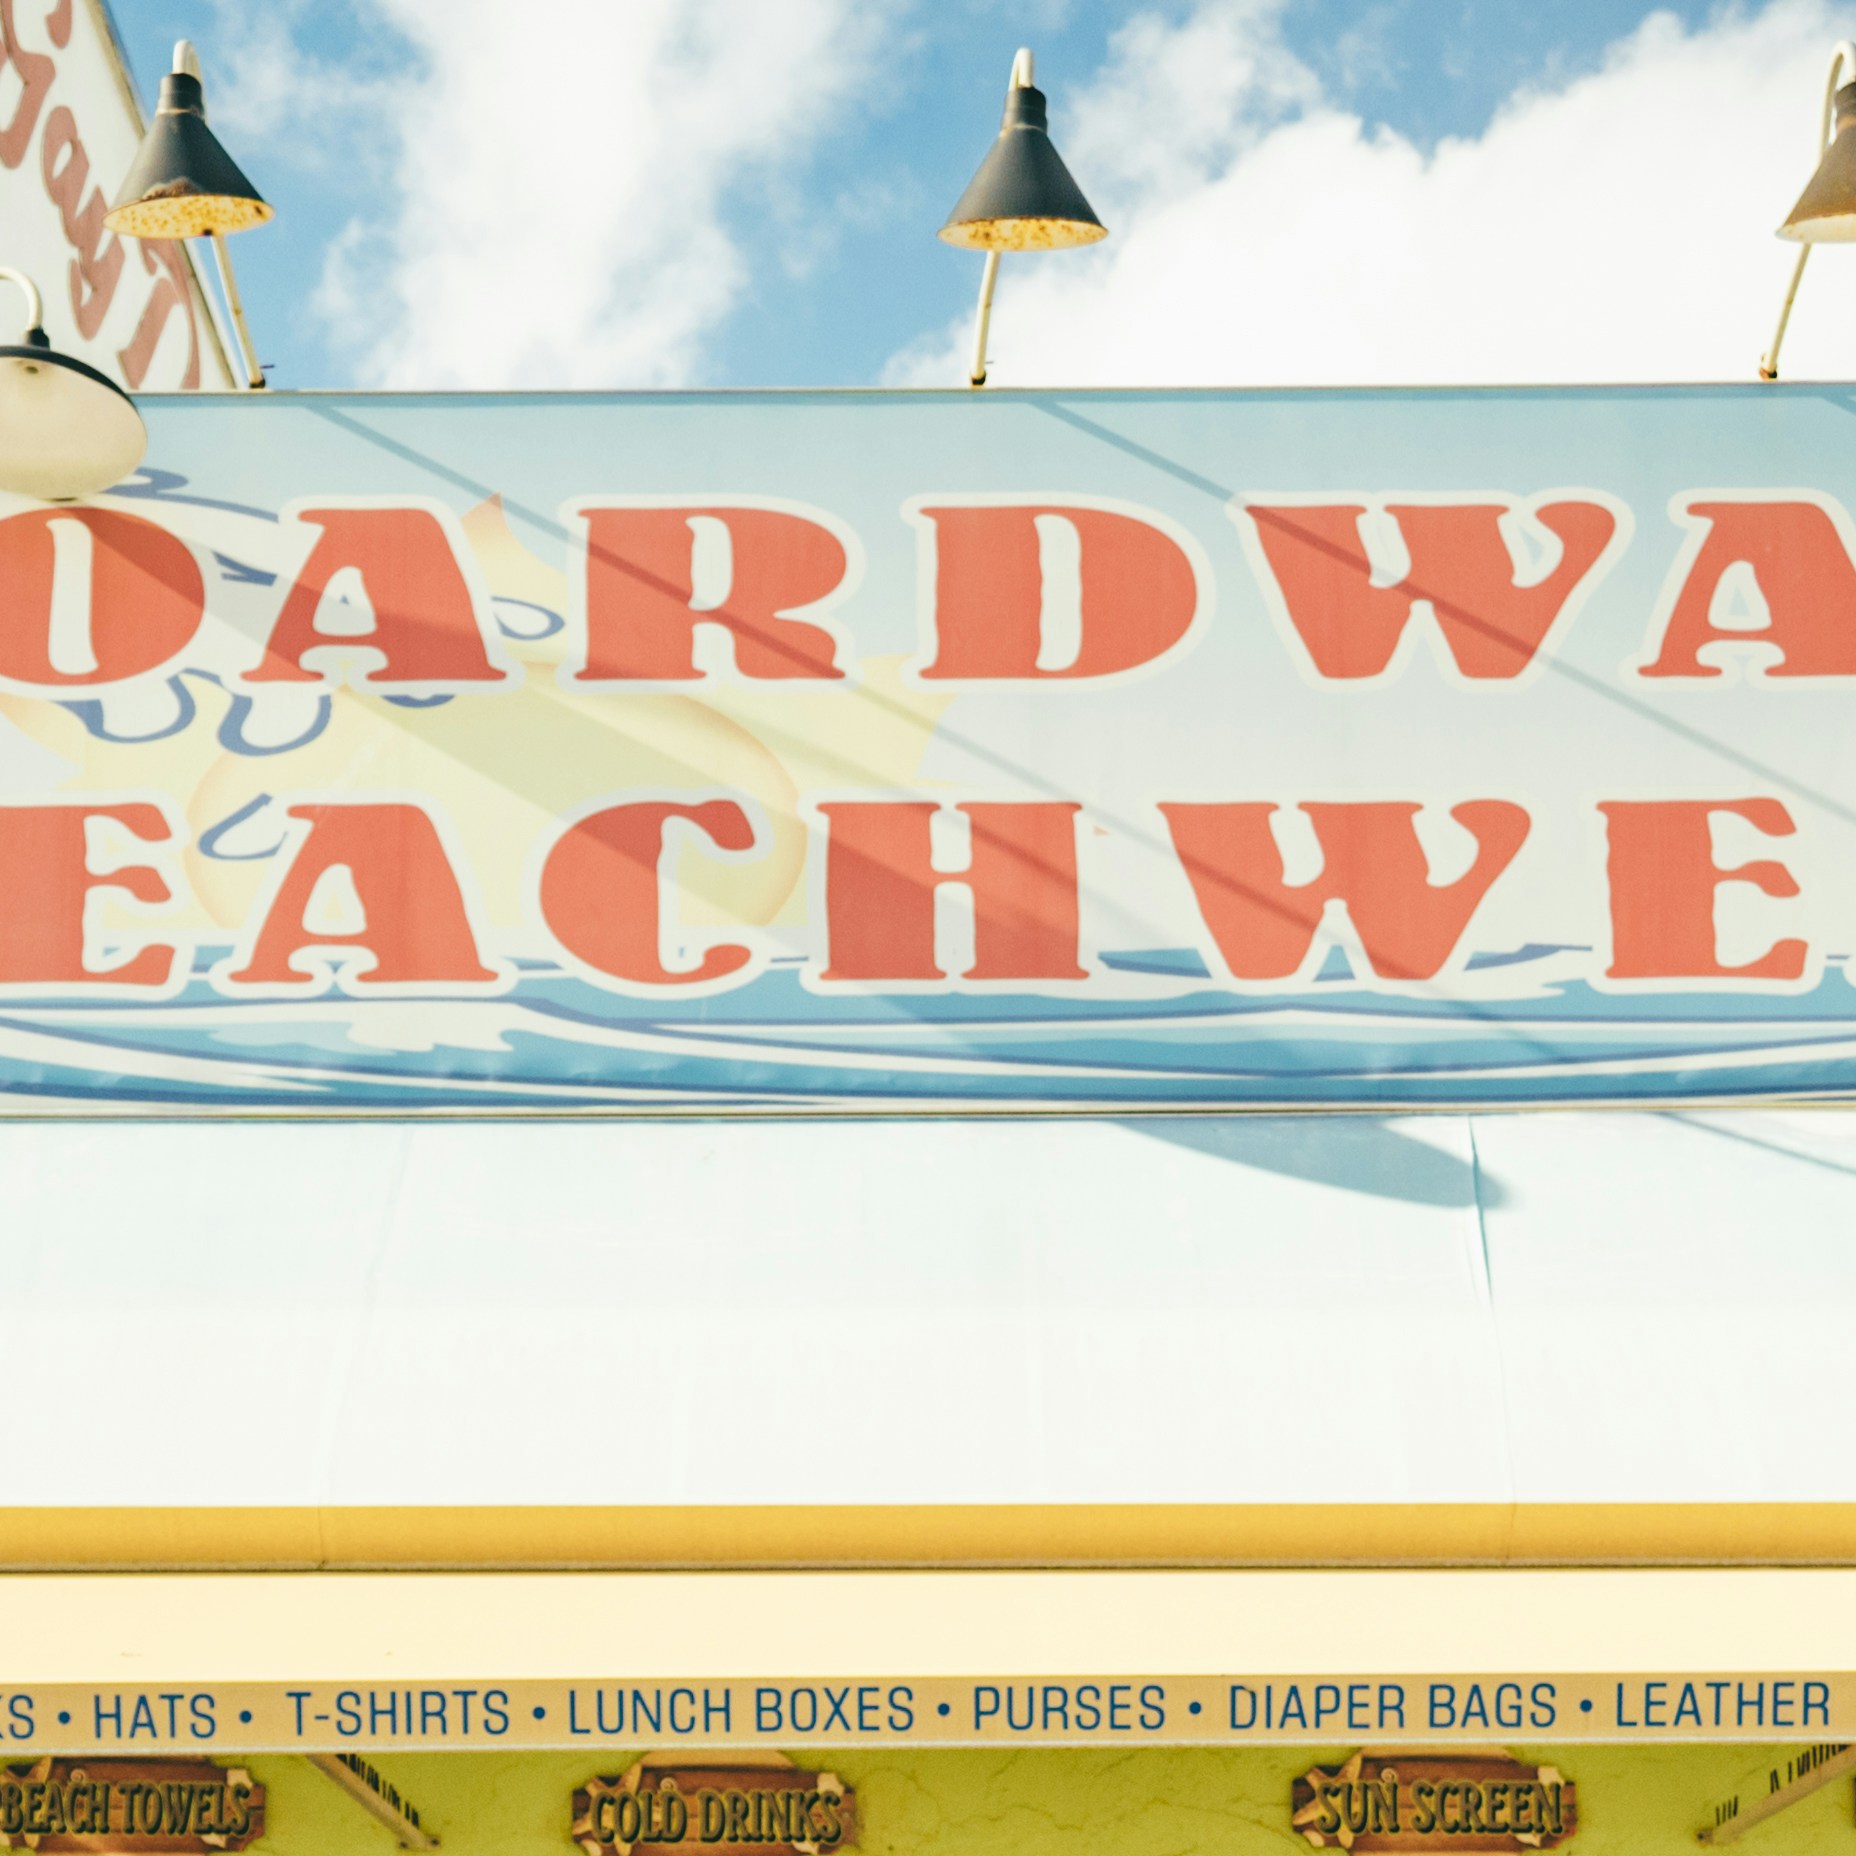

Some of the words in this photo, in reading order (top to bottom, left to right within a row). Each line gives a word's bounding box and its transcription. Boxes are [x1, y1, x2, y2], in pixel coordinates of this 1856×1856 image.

[94, 1692, 217, 1739] HATS
[286, 1689, 510, 1737] T-SHIRTS
[568, 1688, 732, 1736] LUNCH
[754, 1686, 915, 1733] BOXES
[973, 1684, 1166, 1732] PURSES
[1229, 1683, 1406, 1730] DIAPER
[1428, 1682, 1557, 1729] BAGS
[1615, 1681, 1831, 1728] LEATHER
[0, 1781, 111, 1835] BEACH
[117, 1781, 252, 1837] TOWELS
[593, 1789, 689, 1844] COLD
[697, 1788, 843, 1844] DRINKS
[1315, 1780, 1401, 1834] SUN
[1409, 1780, 1564, 1835] SCREEN
